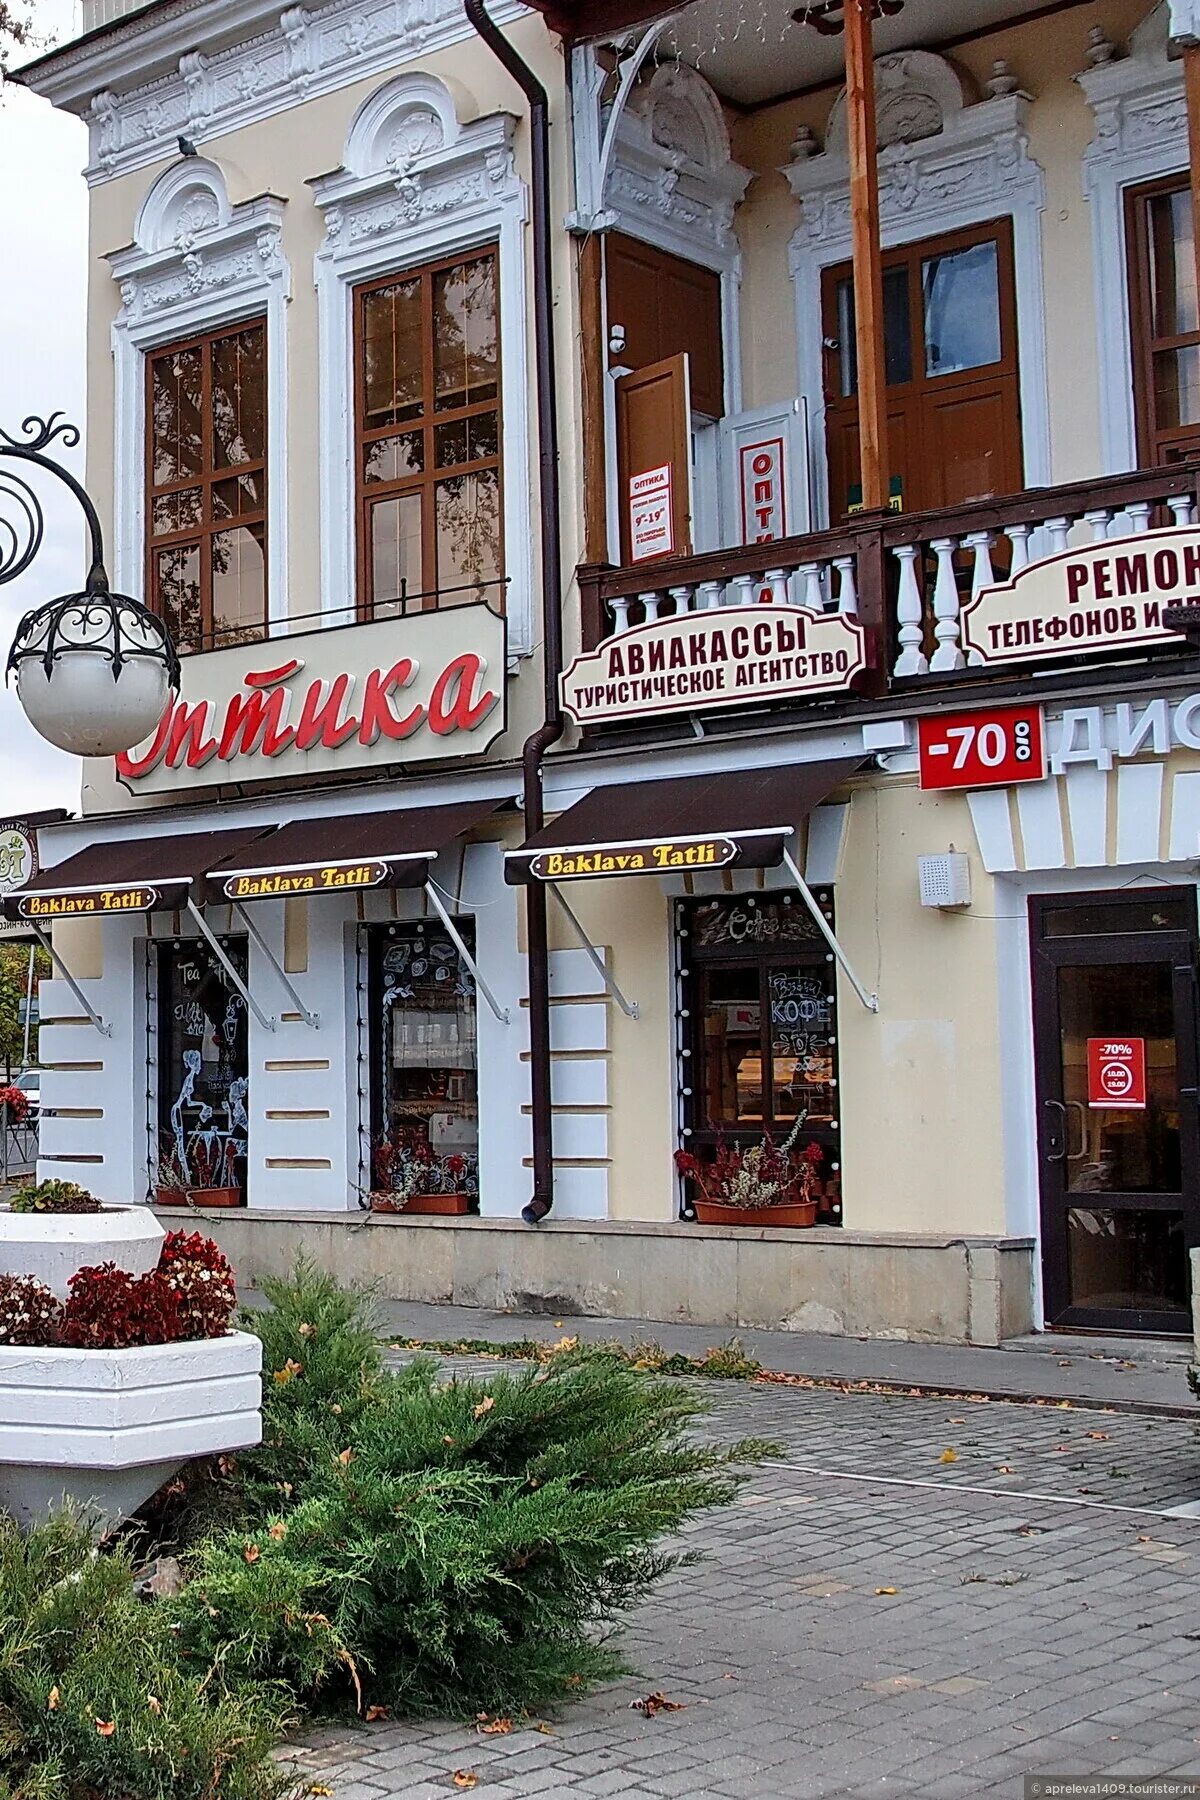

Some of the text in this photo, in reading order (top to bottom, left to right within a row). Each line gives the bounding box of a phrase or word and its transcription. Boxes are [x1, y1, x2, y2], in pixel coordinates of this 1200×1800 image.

[633, 473, 665, 490] ОПТИКА
[987, 601, 1161, 650] ТЕЛЕФОНОВ И
[607, 617, 807, 679] АВИАКАССЫ
[573, 649, 849, 710] ТУРИСТИЧЕСКОЕ АГЕНТСТВО
[547, 844, 716, 875] Baklava Tatli
[237, 867, 371, 895] Baklava Tatli
[30, 892, 142, 914] Baklava Tatli
[177, 962, 200, 985] Tea
[771, 1000, 832, 1023] КОФЕ
[1098, 1044, 1133, 1055] -70%
